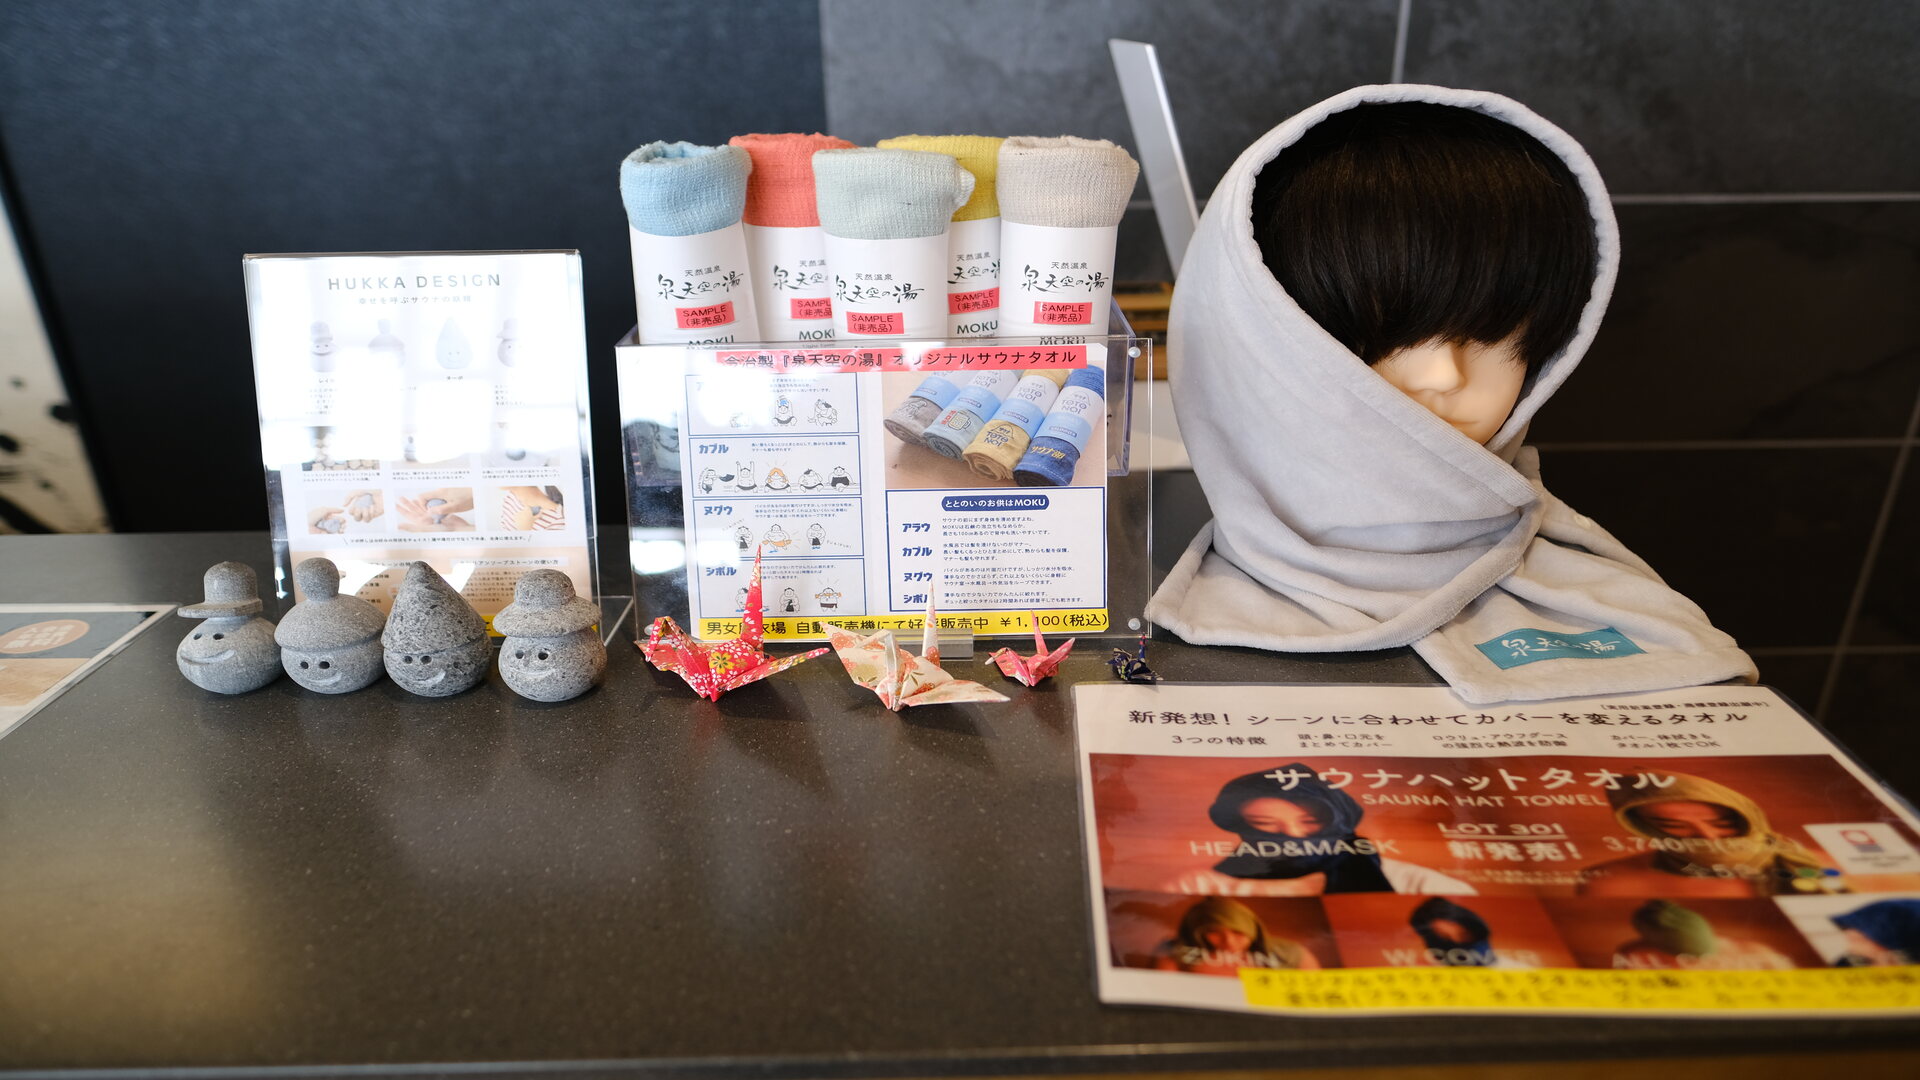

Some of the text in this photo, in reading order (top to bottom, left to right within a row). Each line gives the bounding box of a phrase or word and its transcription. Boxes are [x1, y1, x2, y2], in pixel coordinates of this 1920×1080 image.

[956, 251, 991, 262] 天然温泉
[685, 265, 721, 277] 天然温泉
[948, 259, 1000, 285] 天空の
[1051, 261, 1088, 270] 天然温泉
[327, 273, 501, 290] HUKKA DESIGN
[773, 265, 828, 291] 泉天空
[855, 272, 893, 281] 天然温泉
[1021, 264, 1109, 294] 泉天空の湯
[658, 271, 744, 300] 泉天空の湯
[835, 274, 925, 304] 泉天空の湯
[954, 289, 995, 302] SAMPLE
[682, 304, 727, 318] SAMPLE
[957, 299, 994, 311] (非売品)
[1041, 304, 1085, 313] SAMPLE
[686, 313, 727, 327] (非売品)
[851, 314, 894, 323] SAMPLE
[1042, 313, 1082, 323] (非売品)
[853, 323, 893, 333] (非売品)
[956, 319, 999, 335] MOKU
[893, 350, 1077, 368] オリジナルサウナタオル
[698, 443, 730, 454] カブル
[944, 498, 1046, 508] ととのいのお供はMOKU
[703, 505, 733, 516] ヌグウ
[902, 522, 931, 533] アラウ
[902, 547, 933, 557] カブル
[705, 566, 737, 577] シボル
[903, 572, 933, 582] ヌグウ
[797, 617, 989, 635] 自動販売機にて好販売中
[1129, 711, 1748, 727] 新発想! シーンに合わせてカバーを変えるタオル
[1172, 735, 1268, 746] 3つの特徴
[1264, 766, 1678, 792] サウナハットタオル
[1361, 794, 1609, 807] SAUNA HAT TOWEL
[1437, 822, 1498, 835] LOT
[1190, 838, 1401, 858] HEAD&MASK
[1447, 840, 1583, 862] 新発売!
[1182, 947, 1279, 968] ZUKIN
